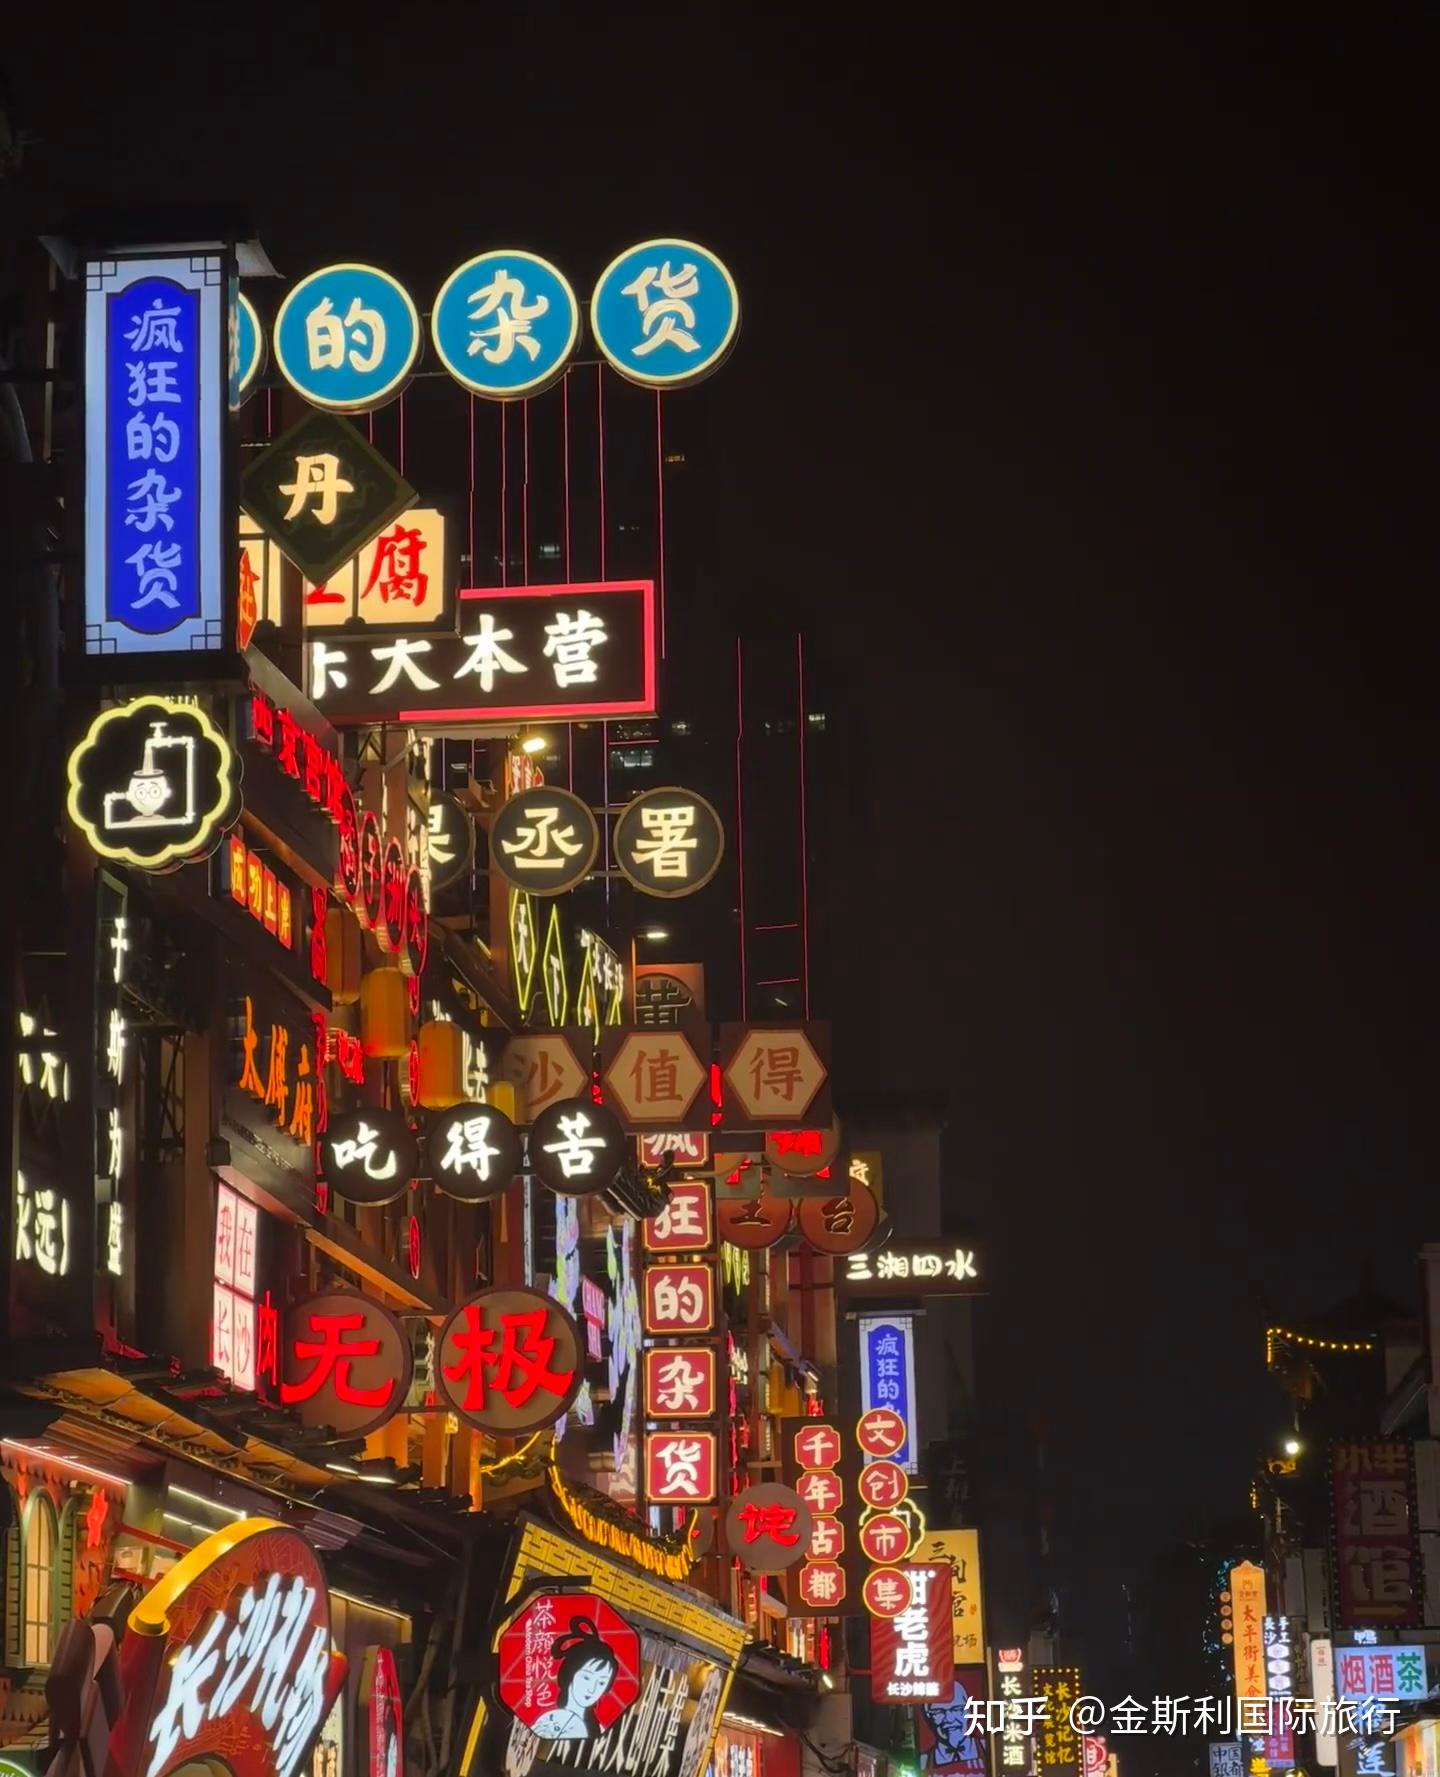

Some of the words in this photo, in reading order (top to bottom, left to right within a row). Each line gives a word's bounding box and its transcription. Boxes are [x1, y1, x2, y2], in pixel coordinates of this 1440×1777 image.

[229, 261, 702, 373] 的杂货
[124, 299, 183, 611] 疯狂的杂货
[278, 452, 355, 525] 丹
[304, 524, 428, 607] 腐
[331, 1111, 607, 1182] 吃得苦
[846, 1249, 977, 1281] 三湘四水
[280, 1304, 576, 1412] 无极
[875, 1334, 901, 1411] 疯狂的
[737, 1503, 799, 1546] 诧
[802, 1431, 837, 1600] 千年古都
[864, 1415, 904, 1611] 文创市集
[533, 1599, 558, 1707] 茶颜悦色
[1340, 1652, 1424, 1694] 烟酒茶
[1056, 1681, 1075, 1765] 长沙记忆
